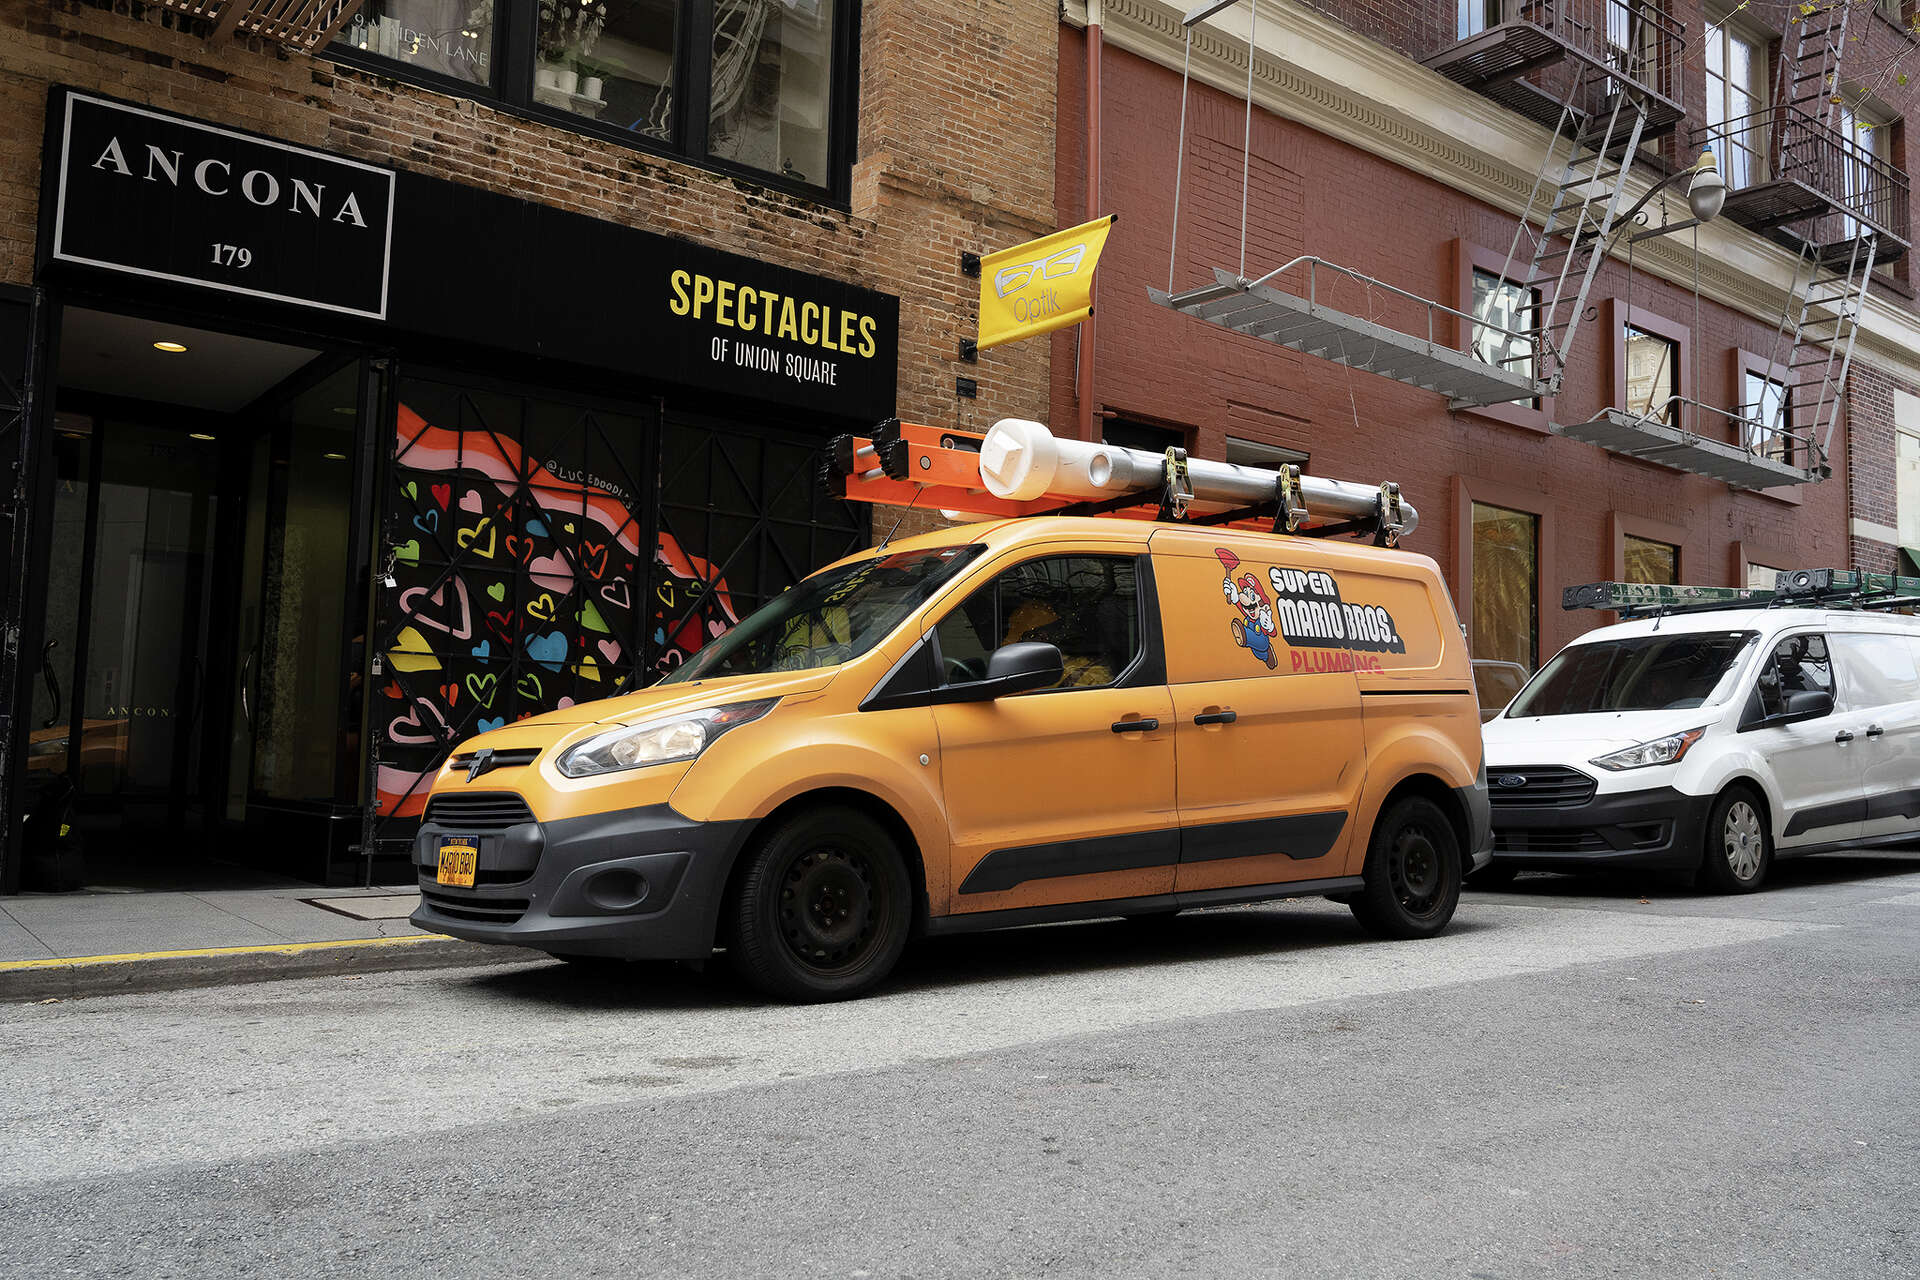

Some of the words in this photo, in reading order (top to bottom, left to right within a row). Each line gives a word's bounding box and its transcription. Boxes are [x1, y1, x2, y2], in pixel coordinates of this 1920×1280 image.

[446, 41, 488, 67] LANE
[91, 136, 368, 228] ANCONA
[210, 243, 252, 269] 179
[669, 269, 877, 359] SPECTACLES
[1013, 287, 1062, 325] Optik
[711, 336, 729, 362] OF
[735, 341, 780, 374] UNION
[785, 353, 838, 386] SQUARE
[1270, 567, 1336, 596] SUPER
[1277, 598, 1345, 640] MARIO
[1343, 603, 1399, 644] BROS.
[107, 706, 176, 718] ANCON
